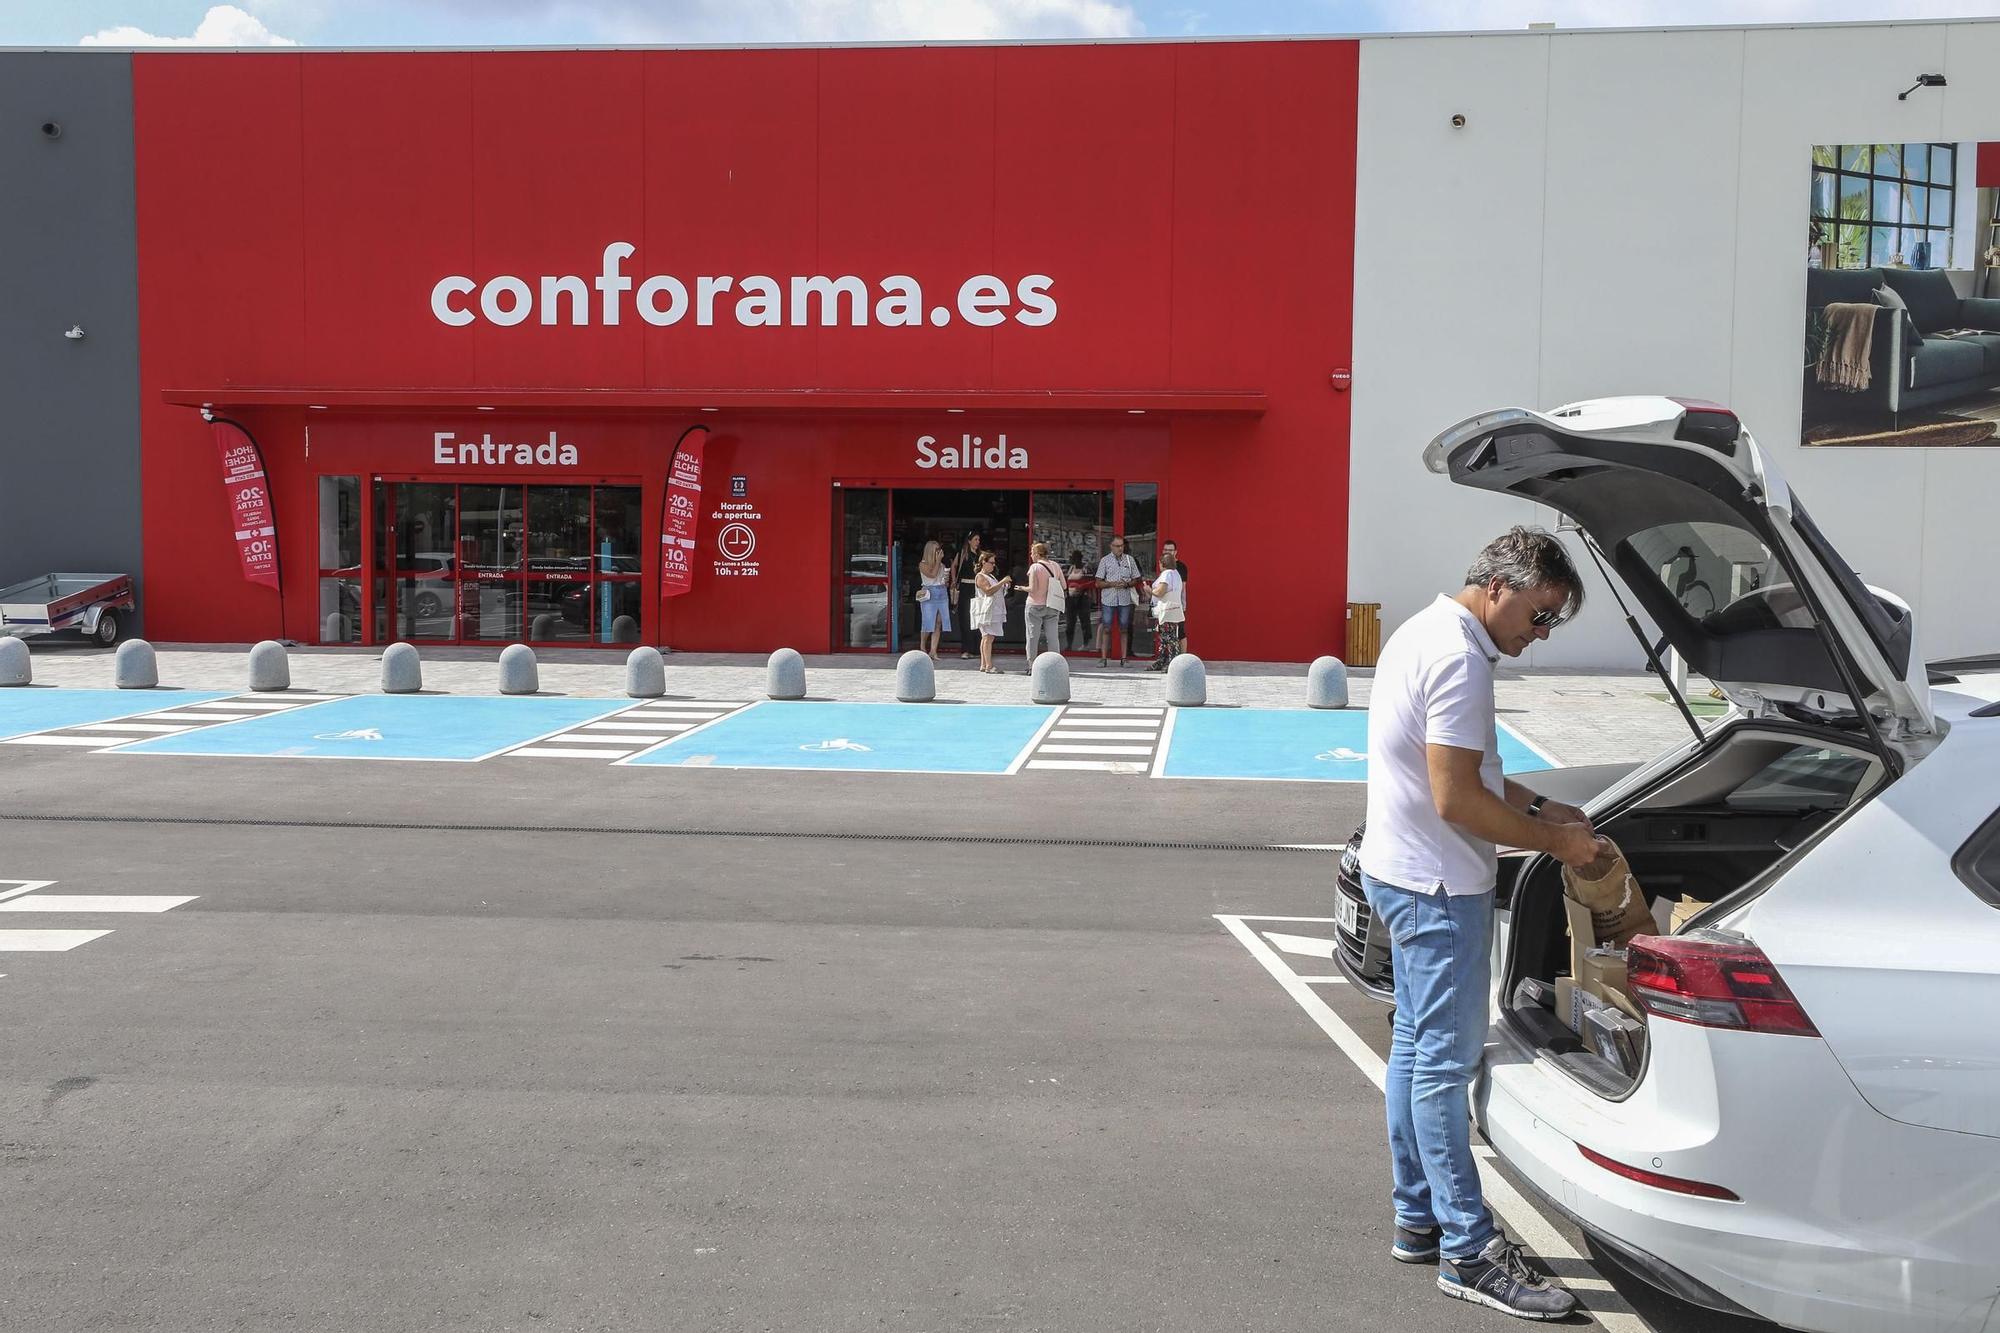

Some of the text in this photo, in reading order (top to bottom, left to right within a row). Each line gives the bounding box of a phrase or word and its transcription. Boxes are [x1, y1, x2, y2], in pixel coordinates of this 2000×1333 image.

[430, 241, 1058, 327] conforama.es
[433, 431, 579, 465] Entrada
[915, 433, 1029, 469] Salida
[712, 511, 761, 520] de apertura
[720, 502, 753, 510] Horario
[715, 567, 731, 576] 10h
[741, 567, 758, 576] 22h
